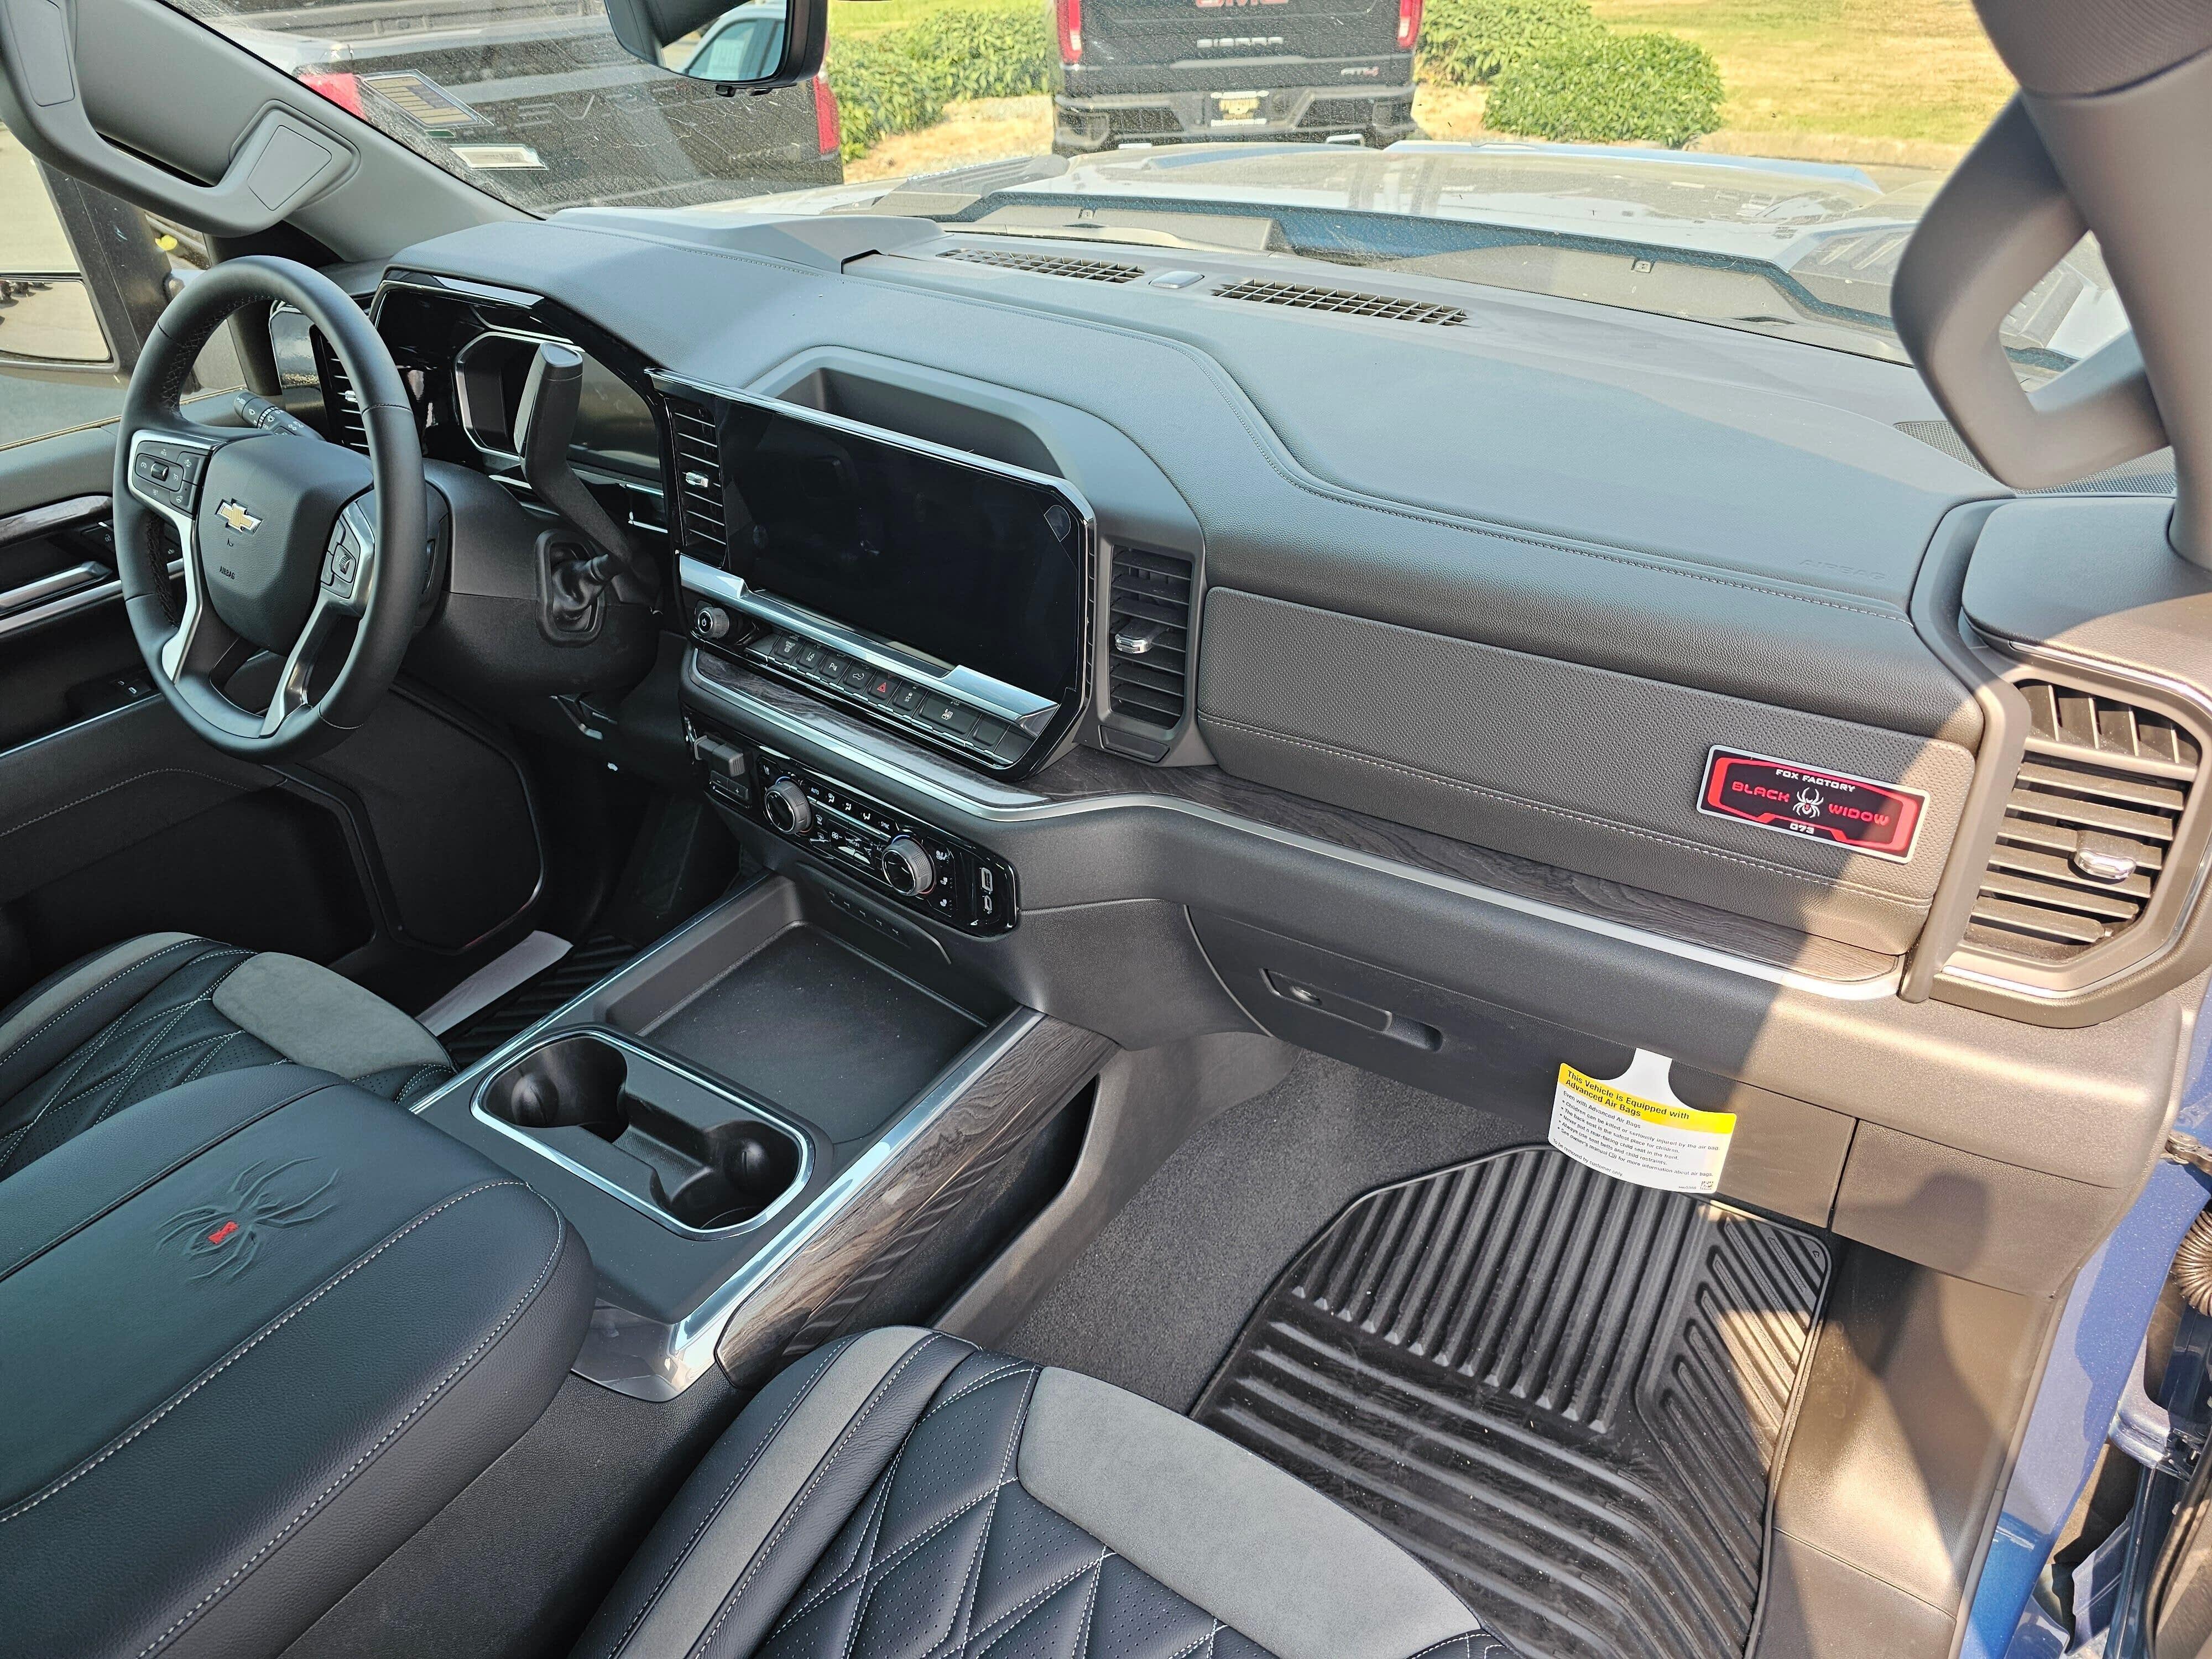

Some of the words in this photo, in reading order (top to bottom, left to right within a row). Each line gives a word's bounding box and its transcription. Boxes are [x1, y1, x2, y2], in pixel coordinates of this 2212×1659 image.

[219, 566, 236, 580] AIRBAG
[811, 787, 820, 795] AUTO
[1775, 768, 1799, 781] FOX
[1802, 774, 1856, 793] FACTORY
[1731, 781, 1790, 803] BLACK
[1828, 803, 1890, 827] WIDOW
[880, 821, 890, 830] SYNC
[1790, 822, 1814, 834] 073
[1566, 1079, 1603, 1103] Advanced
[1605, 1099, 1618, 1108] Air
[1619, 1104, 1641, 1117] Bags
[1568, 1070, 1583, 1084] This
[1585, 1079, 1614, 1098] Vehicle
[1616, 1093, 1624, 1102] is
[1626, 1097, 1667, 1115] Equipped
[1670, 1111, 1690, 1120] with
[1563, 1091, 1575, 1101] Even
[1576, 1098, 1587, 1108] with
[1588, 1105, 1615, 1120] Advanced
[1626, 1120, 1641, 1129] Bags
[1566, 1102, 1586, 1115] Children
[1656, 1138, 1677, 1146] injured
[1574, 1113, 1585, 1123] back
[1562, 1122, 1578, 1134] Always
[1589, 1137, 1599, 1145] seat
[1600, 1142, 1613, 1150] belts
[1563, 1115, 1577, 1125] Never
[1590, 1130, 1619, 1146] rear-facing
[1561, 1128, 1569, 1136] See
[1589, 1144, 1608, 1155] manual
[1642, 1163, 1673, 1173] information
[1564, 1146, 1582, 1160] removed
[1589, 1160, 1611, 1172] customer
